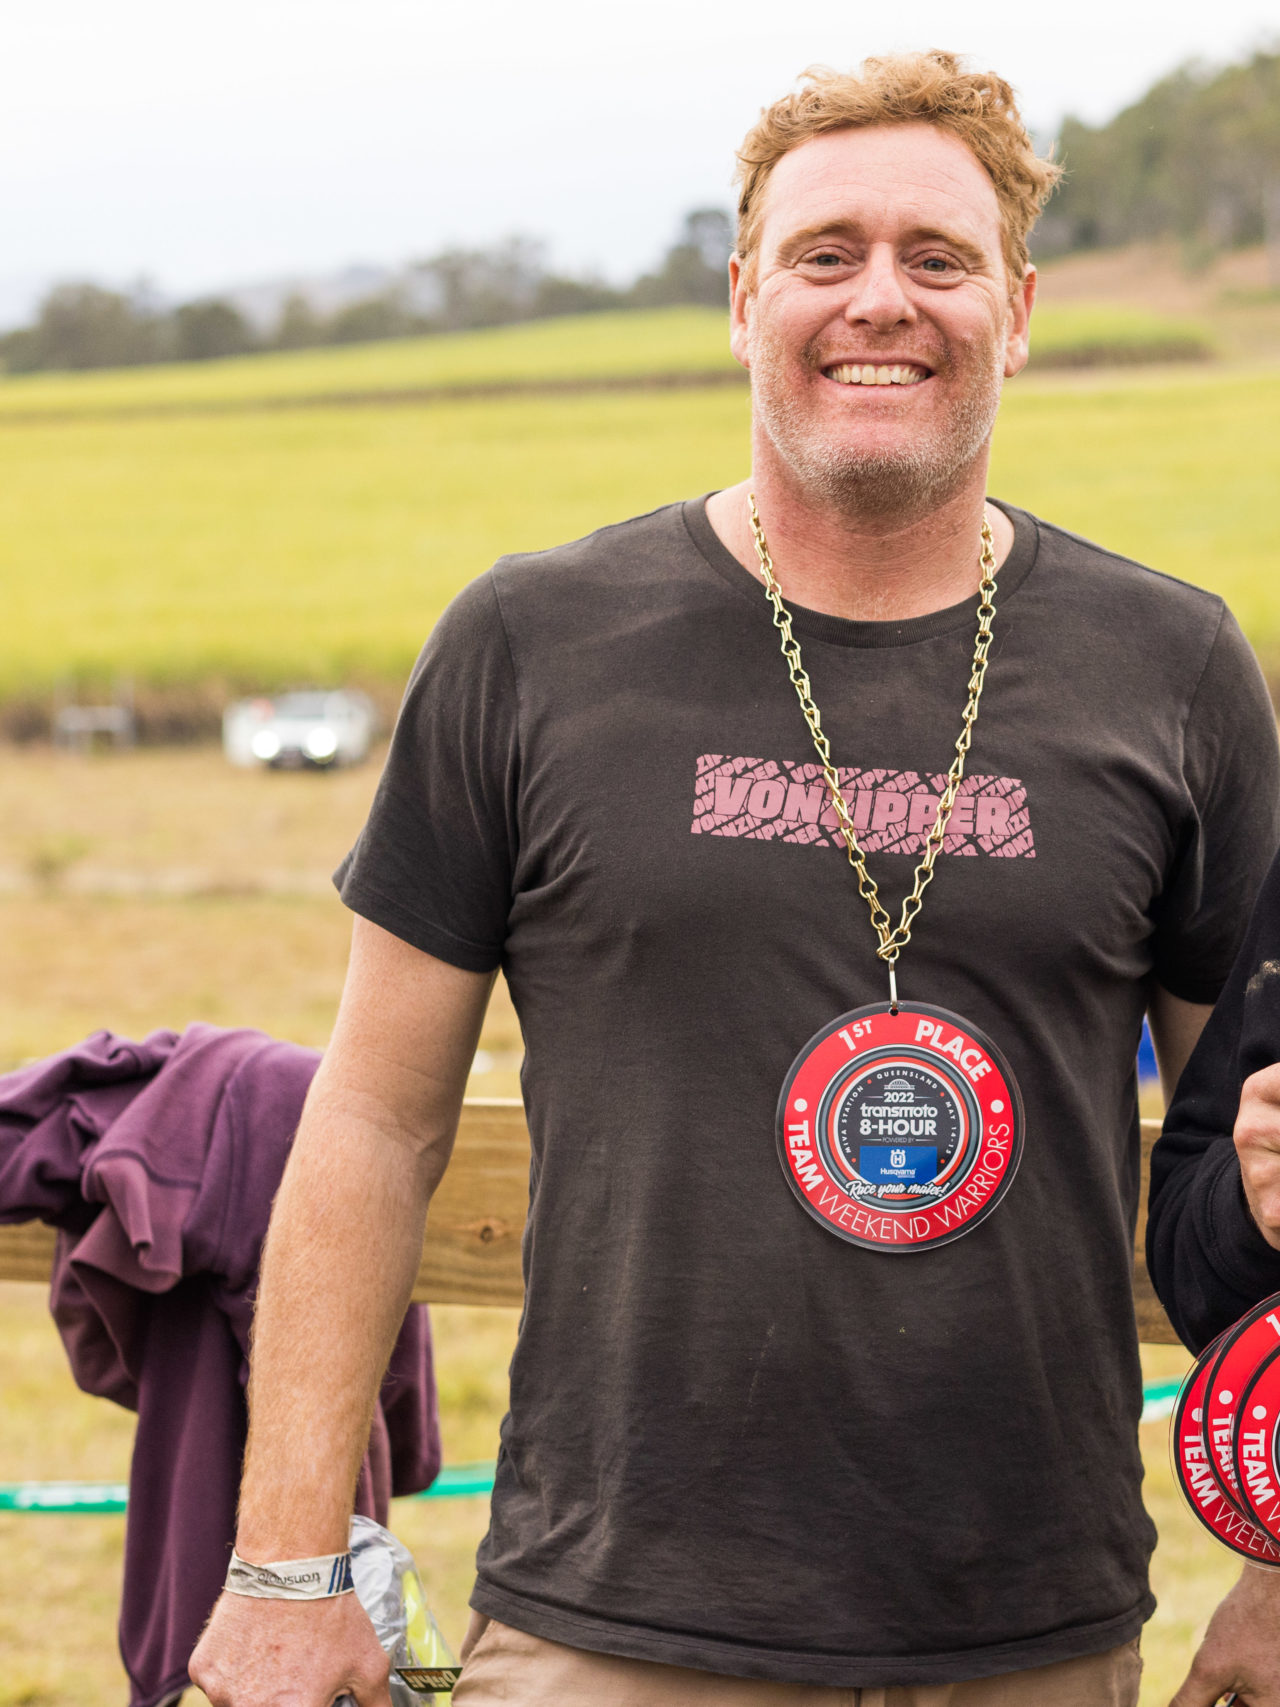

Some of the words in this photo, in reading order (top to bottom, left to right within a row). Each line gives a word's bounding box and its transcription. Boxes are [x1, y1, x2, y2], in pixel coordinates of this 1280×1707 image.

[838, 1020, 872, 1050] 1ST
[915, 1020, 992, 1082] PLACE
[877, 1070, 938, 1089] QUEENSLAND
[842, 1086, 863, 1123] STATION
[884, 1092, 914, 1103] 2022
[860, 1102, 938, 1118] transmoto
[945, 1101, 956, 1120] MAY
[860, 1119, 937, 1136] 8-HOUR
[841, 1130, 852, 1153] MIVA
[788, 1120, 825, 1192] TEAM
[818, 1186, 930, 1240] WEEKEND
[934, 1123, 1010, 1227] WARRIORS
[880, 1168, 916, 1176] Husqvarna
[846, 1180, 876, 1200] Race
[878, 1183, 906, 1198] your
[907, 1182, 950, 1197] mates!
[1184, 1432, 1221, 1507] TEAM
[1243, 1429, 1276, 1505] TEAM
